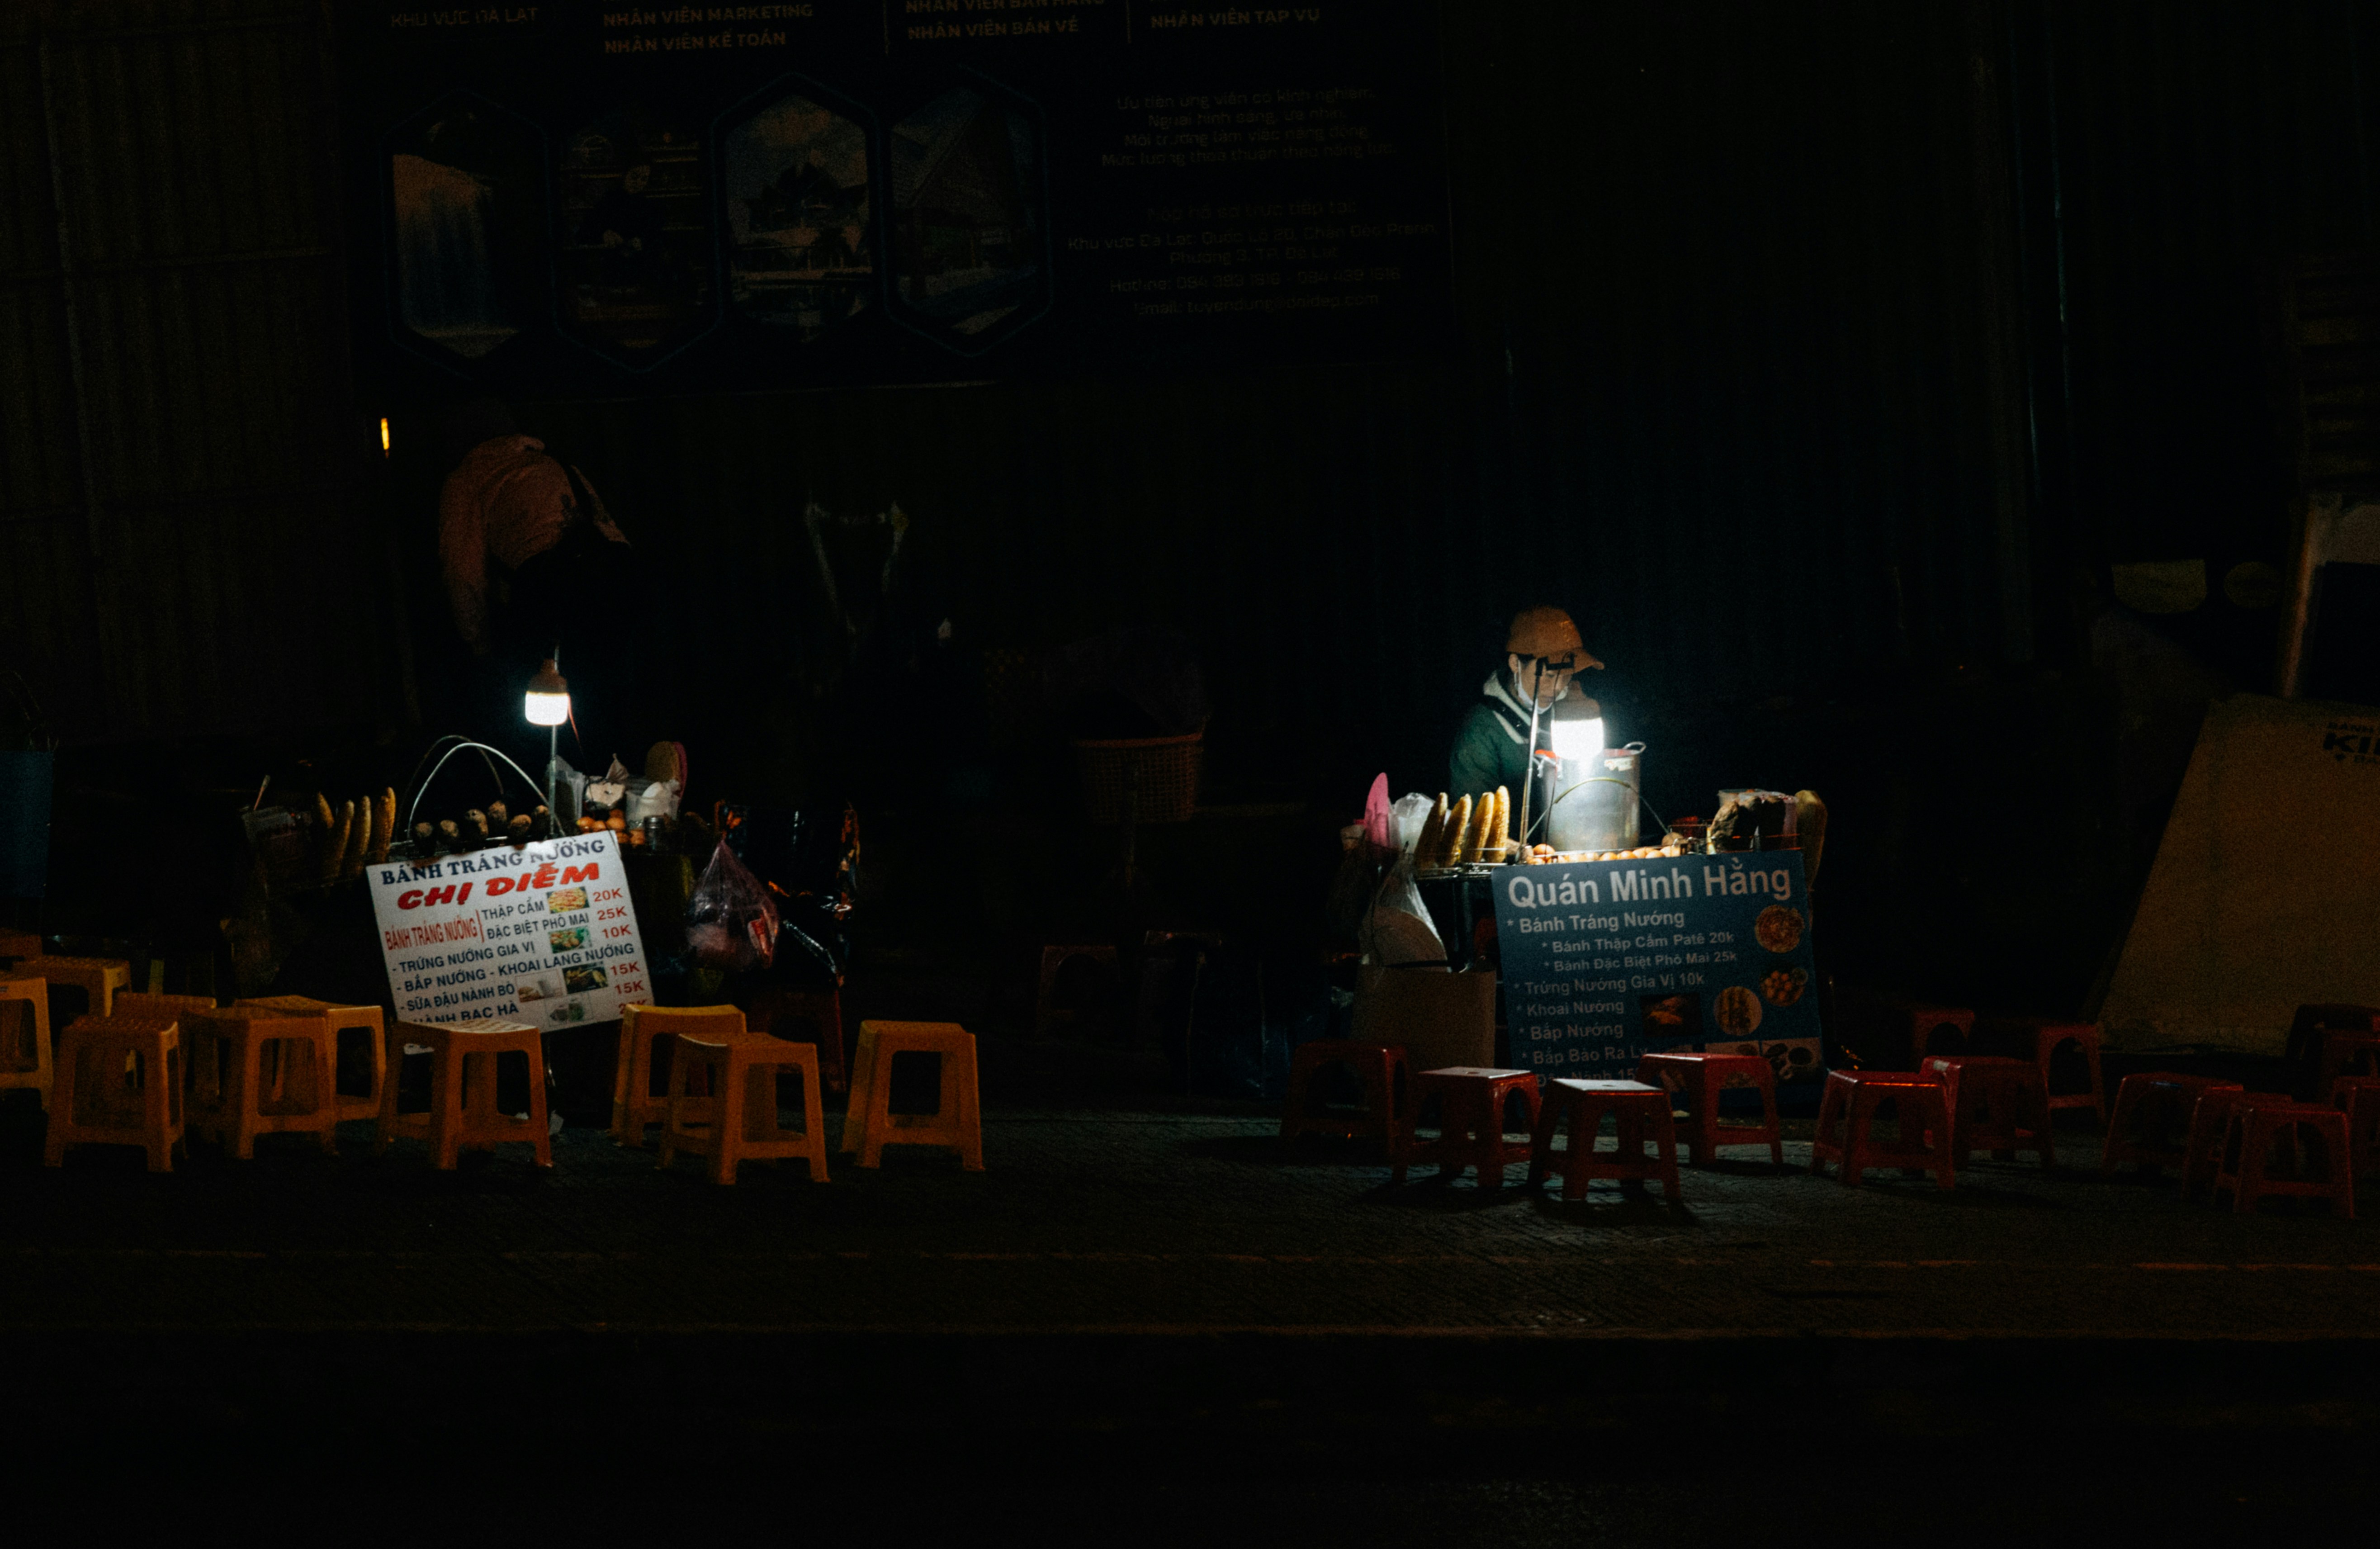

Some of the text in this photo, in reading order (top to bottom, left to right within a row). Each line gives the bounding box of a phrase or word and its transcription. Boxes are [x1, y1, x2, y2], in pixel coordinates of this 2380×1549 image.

[391, 13, 427, 28] KHU
[603, 3, 814, 27] NHÂN VIÊN MARKETING
[908, 14, 1079, 40] NHÂN VIÊN BÁN VÉ
[1150, 6, 1320, 29] NHÂN VIÊN TẠP VỤ
[605, 28, 787, 53] NHÂN VIÊN KẾ TOÁN
[1068, 237, 1099, 251] Khu
[2323, 732, 2380, 755] KI
[381, 864, 442, 885] BÁNH
[447, 852, 523, 875] TRÁNG
[397, 862, 600, 910] CHỊ DIỄM
[1508, 857, 1792, 909] Quán Minh Hằng
[482, 888, 623, 920] THẬP CẨM 20K
[385, 914, 478, 950] BÁNH TRÁNG NƯỚNG
[487, 905, 628, 940] ĐẶC BIỆT PHÔ MAI 25K
[1519, 910, 1685, 933] Bánh Tráng Nướng
[399, 924, 632, 973] TRỨNG NƯỚNG GIA VỊ 10K
[1552, 931, 1735, 953] Bánh Thập Cẩm Patê 20k
[405, 943, 640, 992] BẮP NƯỚNG KHOAI LANG NƯỚNG 15K
[1553, 951, 1737, 972] Bánh Đặc Biệt Phô Mai 25k
[407, 996, 432, 1011] SỮA
[434, 992, 459, 1008] ĐẬU
[462, 986, 495, 1002] NÀNH
[614, 980, 644, 995] 15K
[1524, 972, 1705, 996] Trứng Nướng Gia Vị 10k
[497, 1000, 519, 1015] HÀ
[1526, 1000, 1625, 1017] Khoai Nướng
[1530, 1022, 1624, 1041] Bắp Nướng
[1533, 1046, 1564, 1066] Bắp
[1604, 1046, 1626, 1061] Ra
[1617, 1067, 1639, 1080] 15
